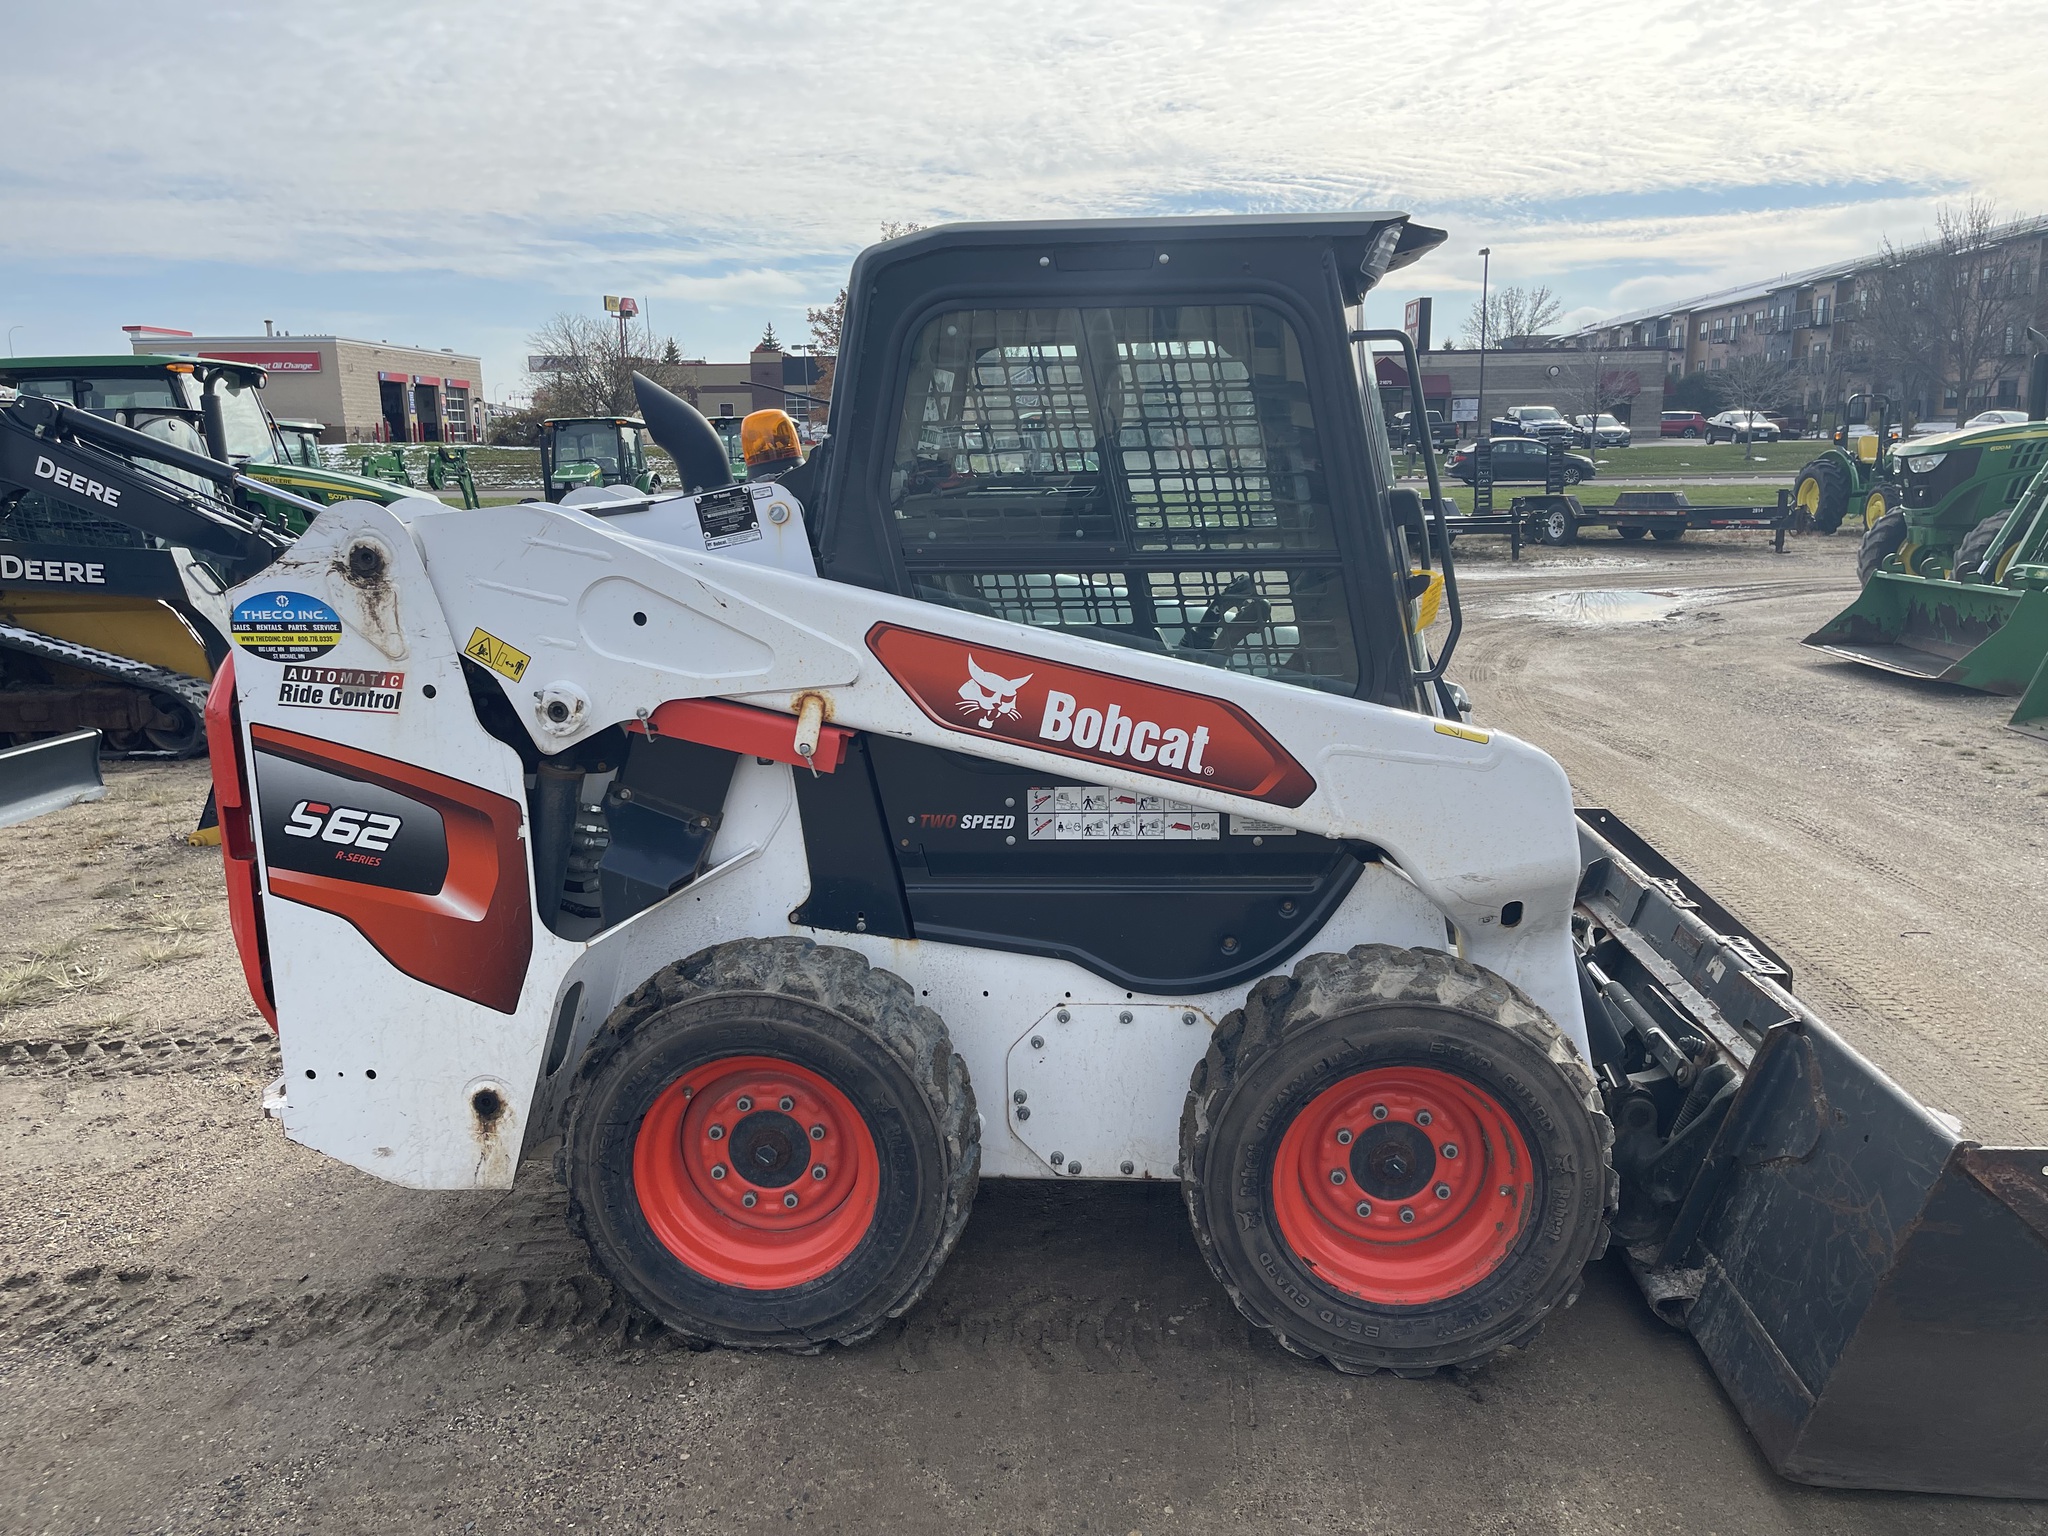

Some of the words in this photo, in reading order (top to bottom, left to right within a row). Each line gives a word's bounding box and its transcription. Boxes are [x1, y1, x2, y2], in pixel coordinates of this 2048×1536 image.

[283, 362, 313, 370] Change
[34, 455, 122, 508] DEERE
[270, 476, 293, 485] DEERE
[0, 554, 106, 584] DEERE
[241, 610, 296, 620] THECO
[298, 610, 329, 620] INC.
[287, 668, 401, 688] AUTOMATIC
[278, 683, 324, 704] Ride
[329, 686, 403, 710] Control
[1038, 689, 1210, 775] Bobcat
[283, 800, 402, 852] S62
[919, 813, 957, 830] TWO
[960, 813, 1016, 831] SPEED
[335, 850, 382, 867] R-SERIES
[1259, 1251, 1312, 1309] GUARD
[1319, 1307, 1381, 1340] BEAD
